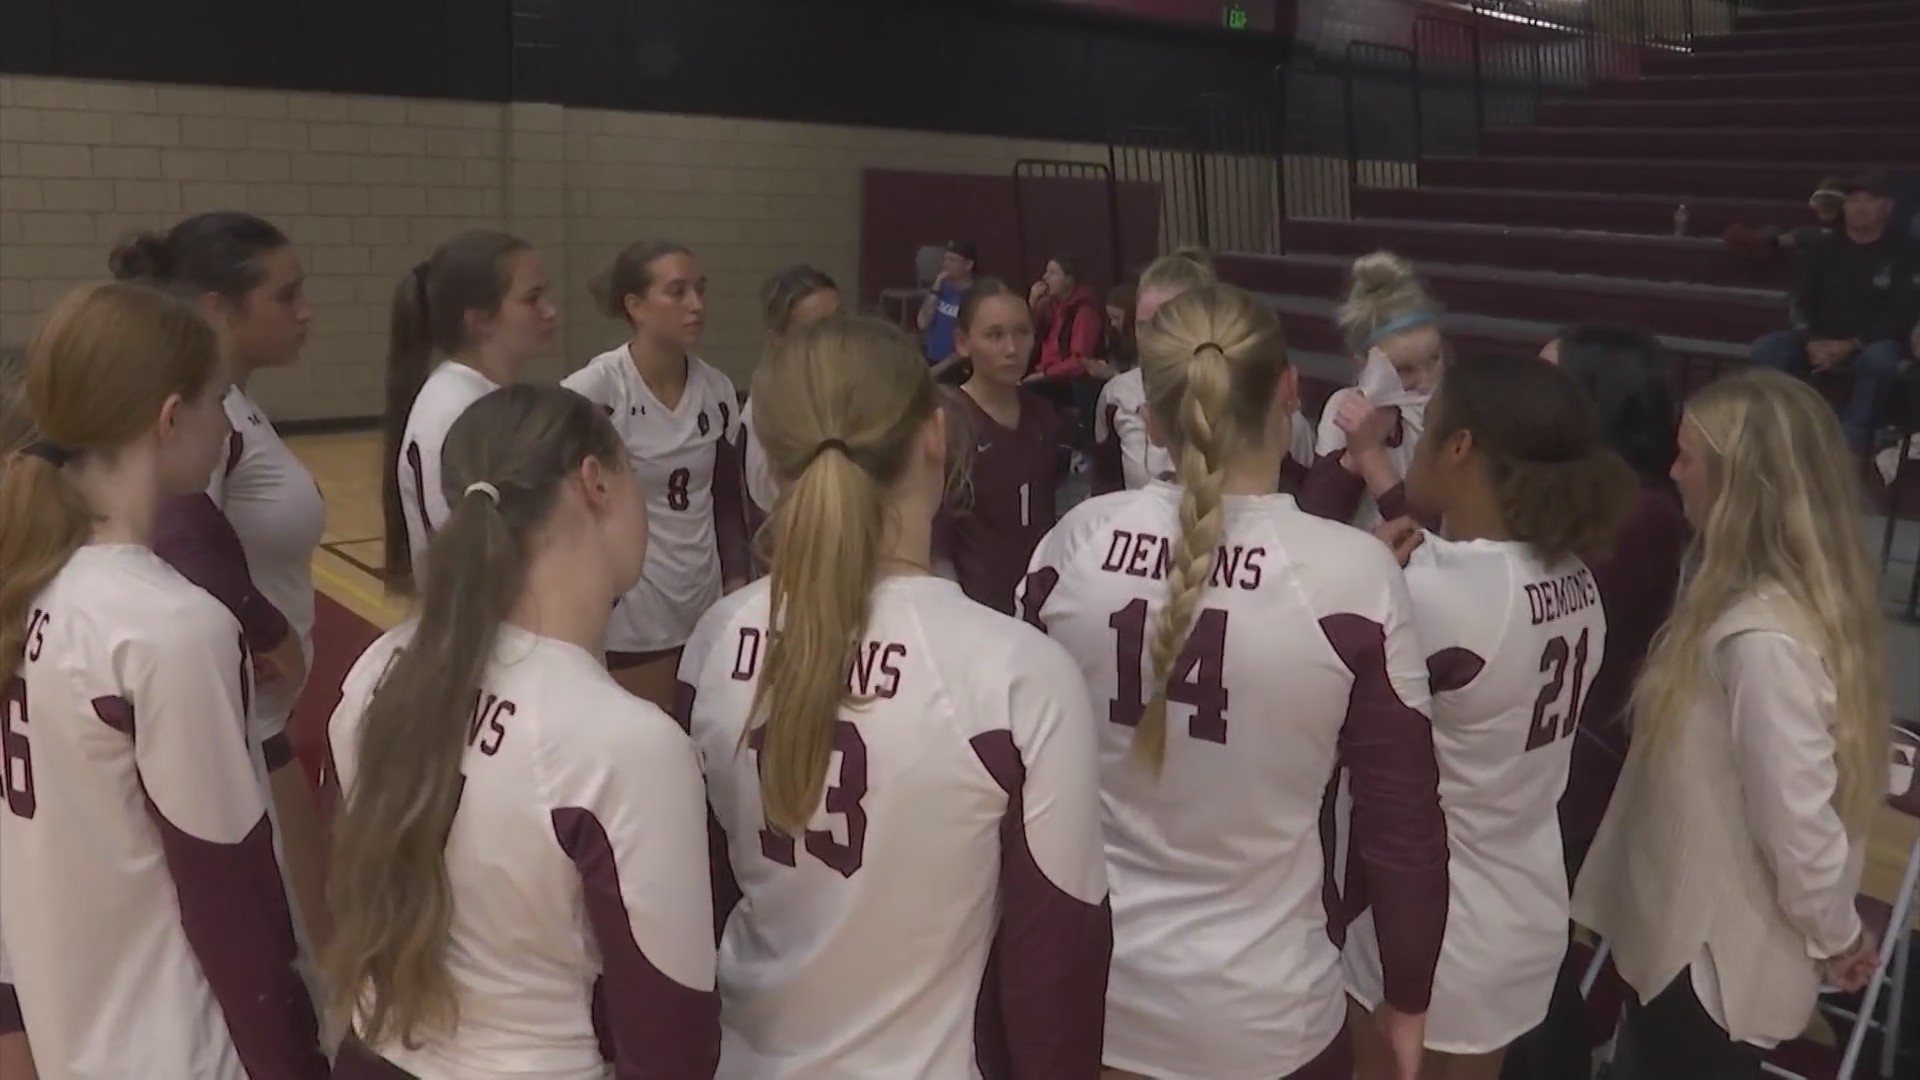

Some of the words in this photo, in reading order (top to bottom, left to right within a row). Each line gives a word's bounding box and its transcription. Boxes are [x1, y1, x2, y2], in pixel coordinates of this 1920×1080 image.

[667, 467, 690, 511] 8
[1018, 483, 1031, 526] 1
[1101, 529, 1266, 590] DEMNS
[1523, 569, 1596, 626] DEMONS
[731, 627, 906, 699] DNS
[1108, 598, 1229, 744] 14
[1525, 627, 1589, 752] 21
[0, 676, 37, 820] 6
